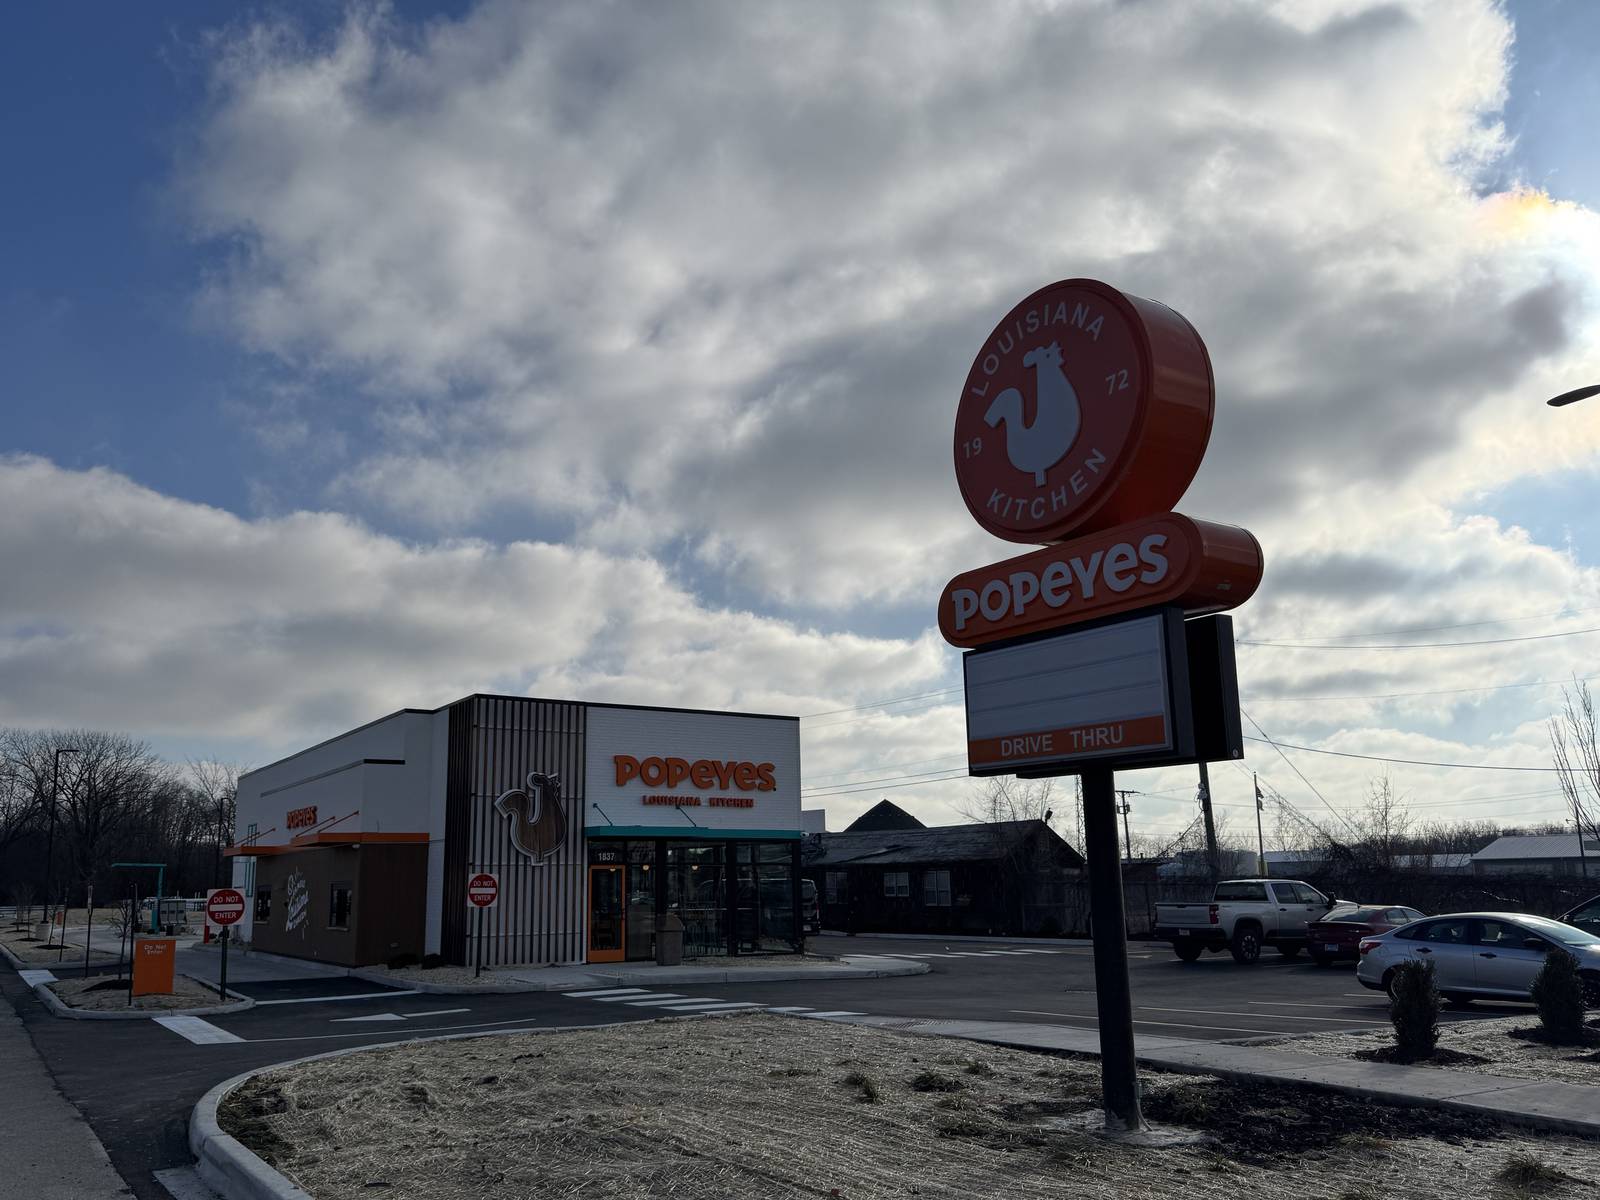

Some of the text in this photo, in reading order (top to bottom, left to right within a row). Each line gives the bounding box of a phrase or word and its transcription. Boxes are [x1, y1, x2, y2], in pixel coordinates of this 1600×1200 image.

[971, 301, 1105, 397] LOUISIANA
[1105, 369, 1129, 396] 72
[963, 437, 982, 459] 19
[987, 448, 1106, 520] KITCHEN
[1001, 726, 1123, 757] DRIVE THRU
[597, 852, 615, 861] 1837
[213, 895, 239, 904] DO NOT
[215, 911, 237, 919] ENTER
